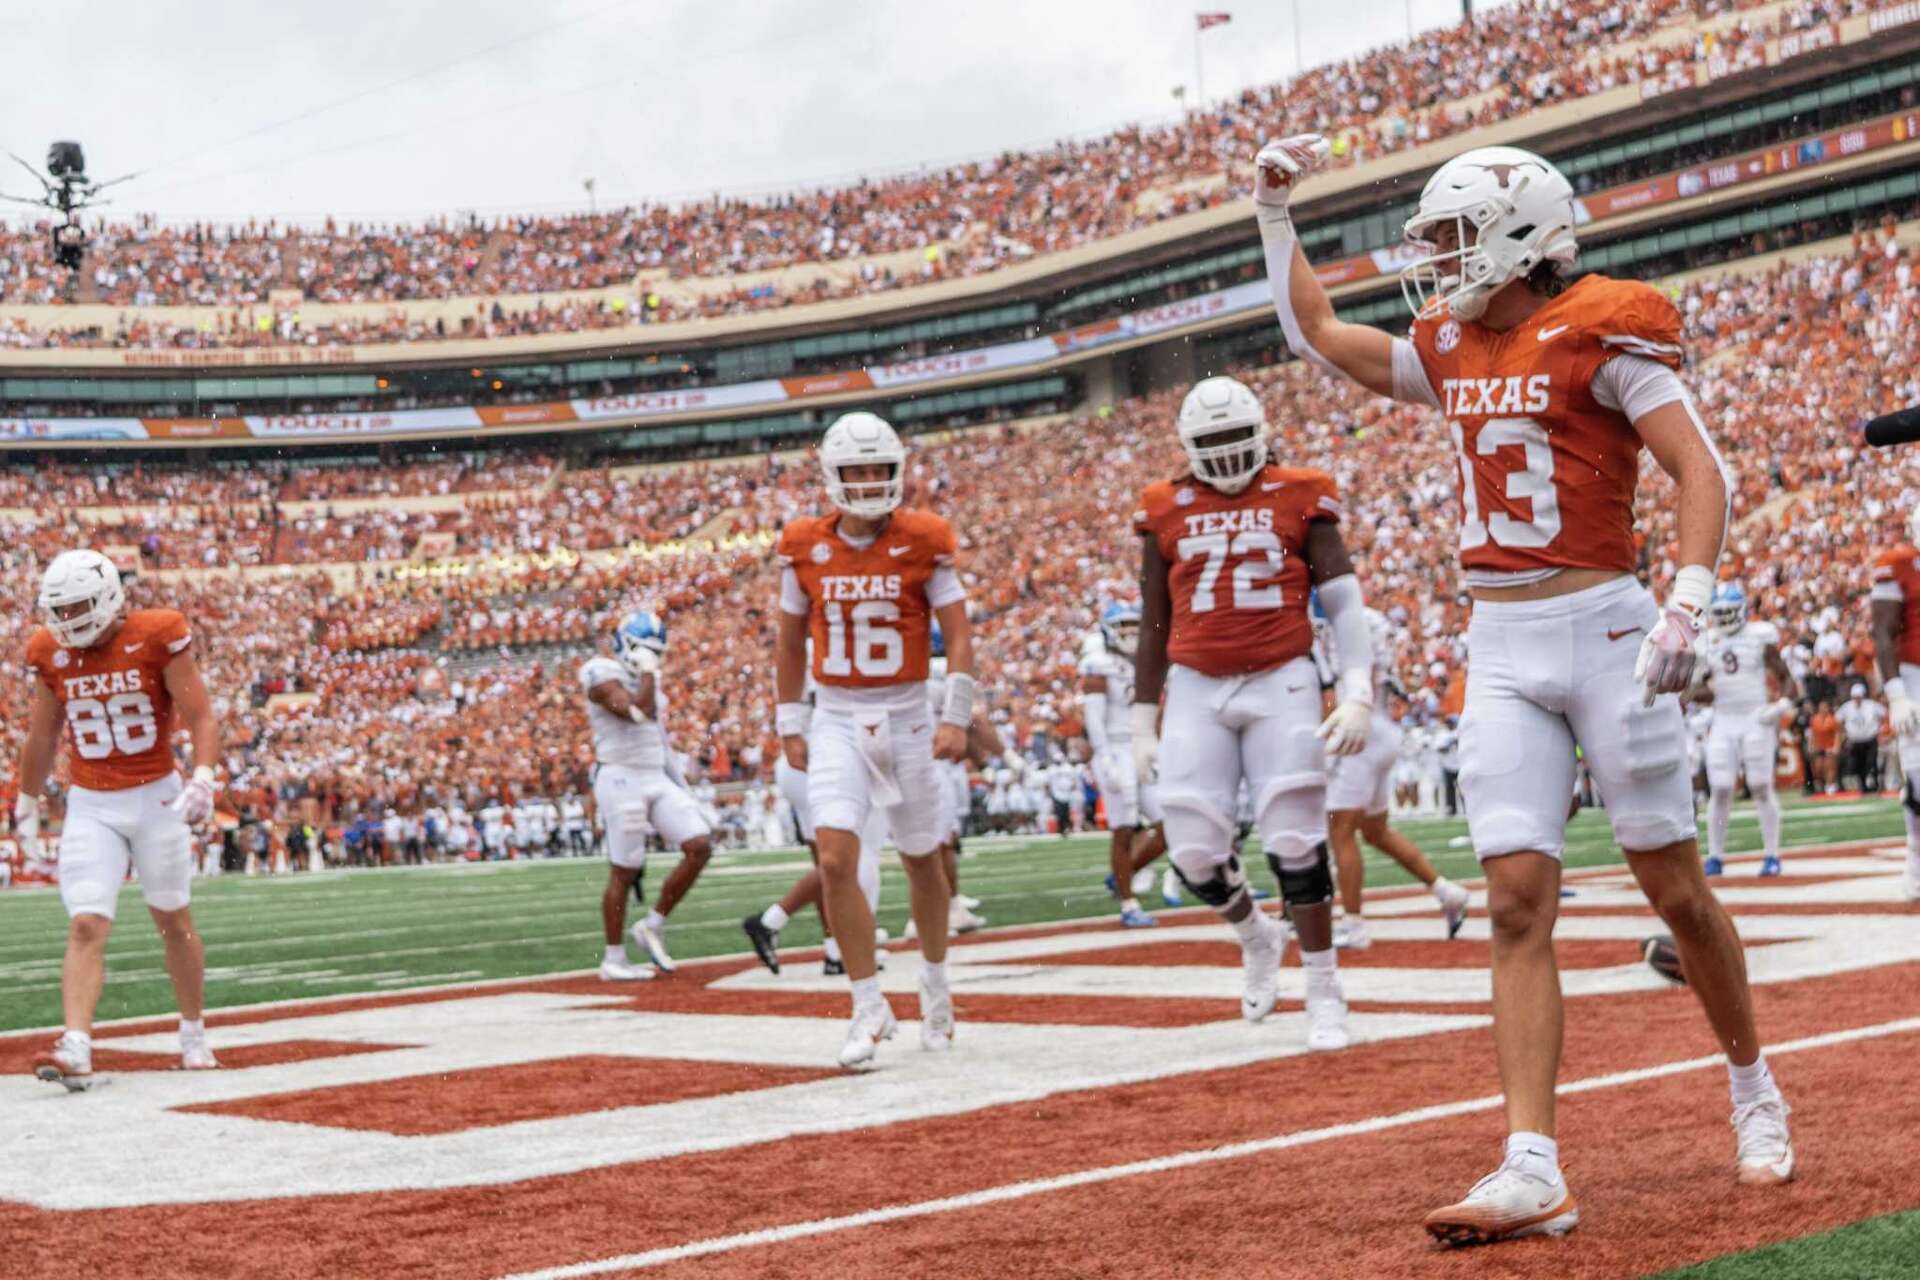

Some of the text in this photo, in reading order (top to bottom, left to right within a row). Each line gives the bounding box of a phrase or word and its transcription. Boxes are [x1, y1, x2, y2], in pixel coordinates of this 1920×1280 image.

[588, 396, 679, 411] TOUCH
[1443, 374, 1551, 416] TEXAS
[263, 415, 363, 431] TOUCH
[1450, 417, 1562, 550] 13
[1184, 508, 1274, 536] TEXAS
[820, 575, 902, 600] TEXAS
[1177, 531, 1285, 614] 72
[821, 600, 904, 677] 16
[64, 669, 142, 699] TEXAS
[65, 692, 158, 759] 88
